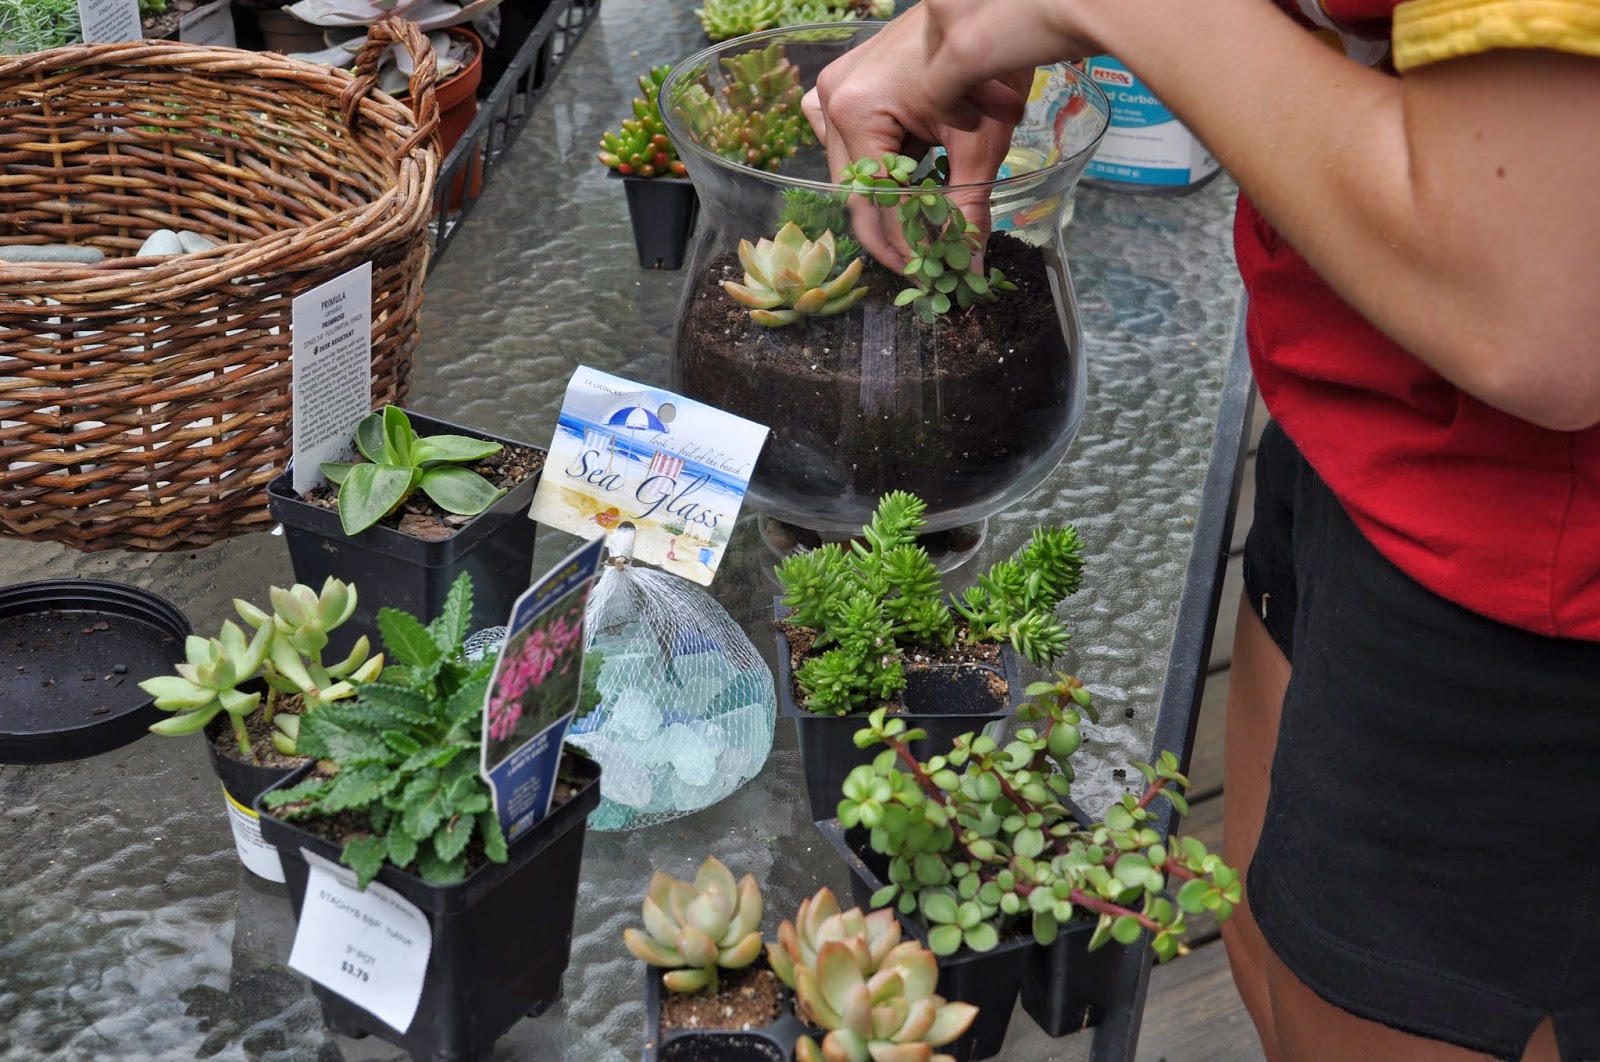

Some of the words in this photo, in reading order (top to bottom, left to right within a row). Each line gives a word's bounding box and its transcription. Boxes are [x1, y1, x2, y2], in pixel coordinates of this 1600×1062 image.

[1094, 69, 1125, 82] PETCO
[321, 291, 346, 311] PRIMULA
[322, 313, 345, 330] PRIMROSE
[319, 342, 330, 352] DEER
[331, 330, 354, 346] RESISTANT
[593, 383, 622, 397] OUNCES
[649, 433, 674, 449] look
[674, 442, 700, 459] feel
[706, 453, 724, 467] the
[720, 458, 750, 476] beach
[565, 450, 625, 492] Sea
[628, 474, 723, 528] Glass
[357, 950, 376, 967] POT
[341, 959, 370, 983] $3.79
